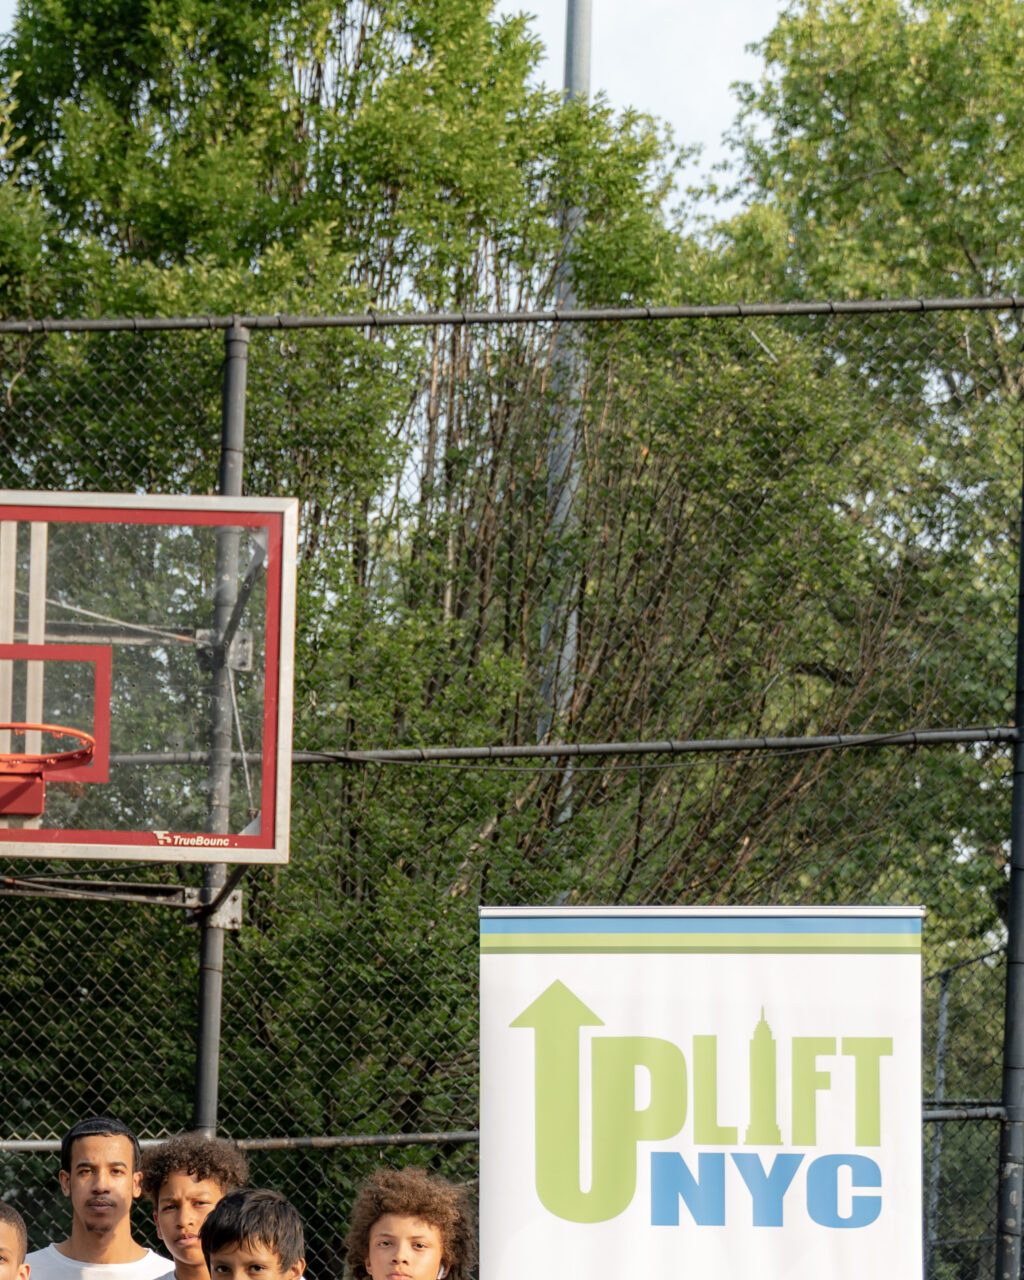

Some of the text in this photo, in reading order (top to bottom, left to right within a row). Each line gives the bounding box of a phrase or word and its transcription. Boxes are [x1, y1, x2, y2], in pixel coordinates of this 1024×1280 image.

[173, 835, 230, 846] TrueBounc
[508, 979, 893, 1224] UPLIFT
[650, 1152, 882, 1229] NYC
